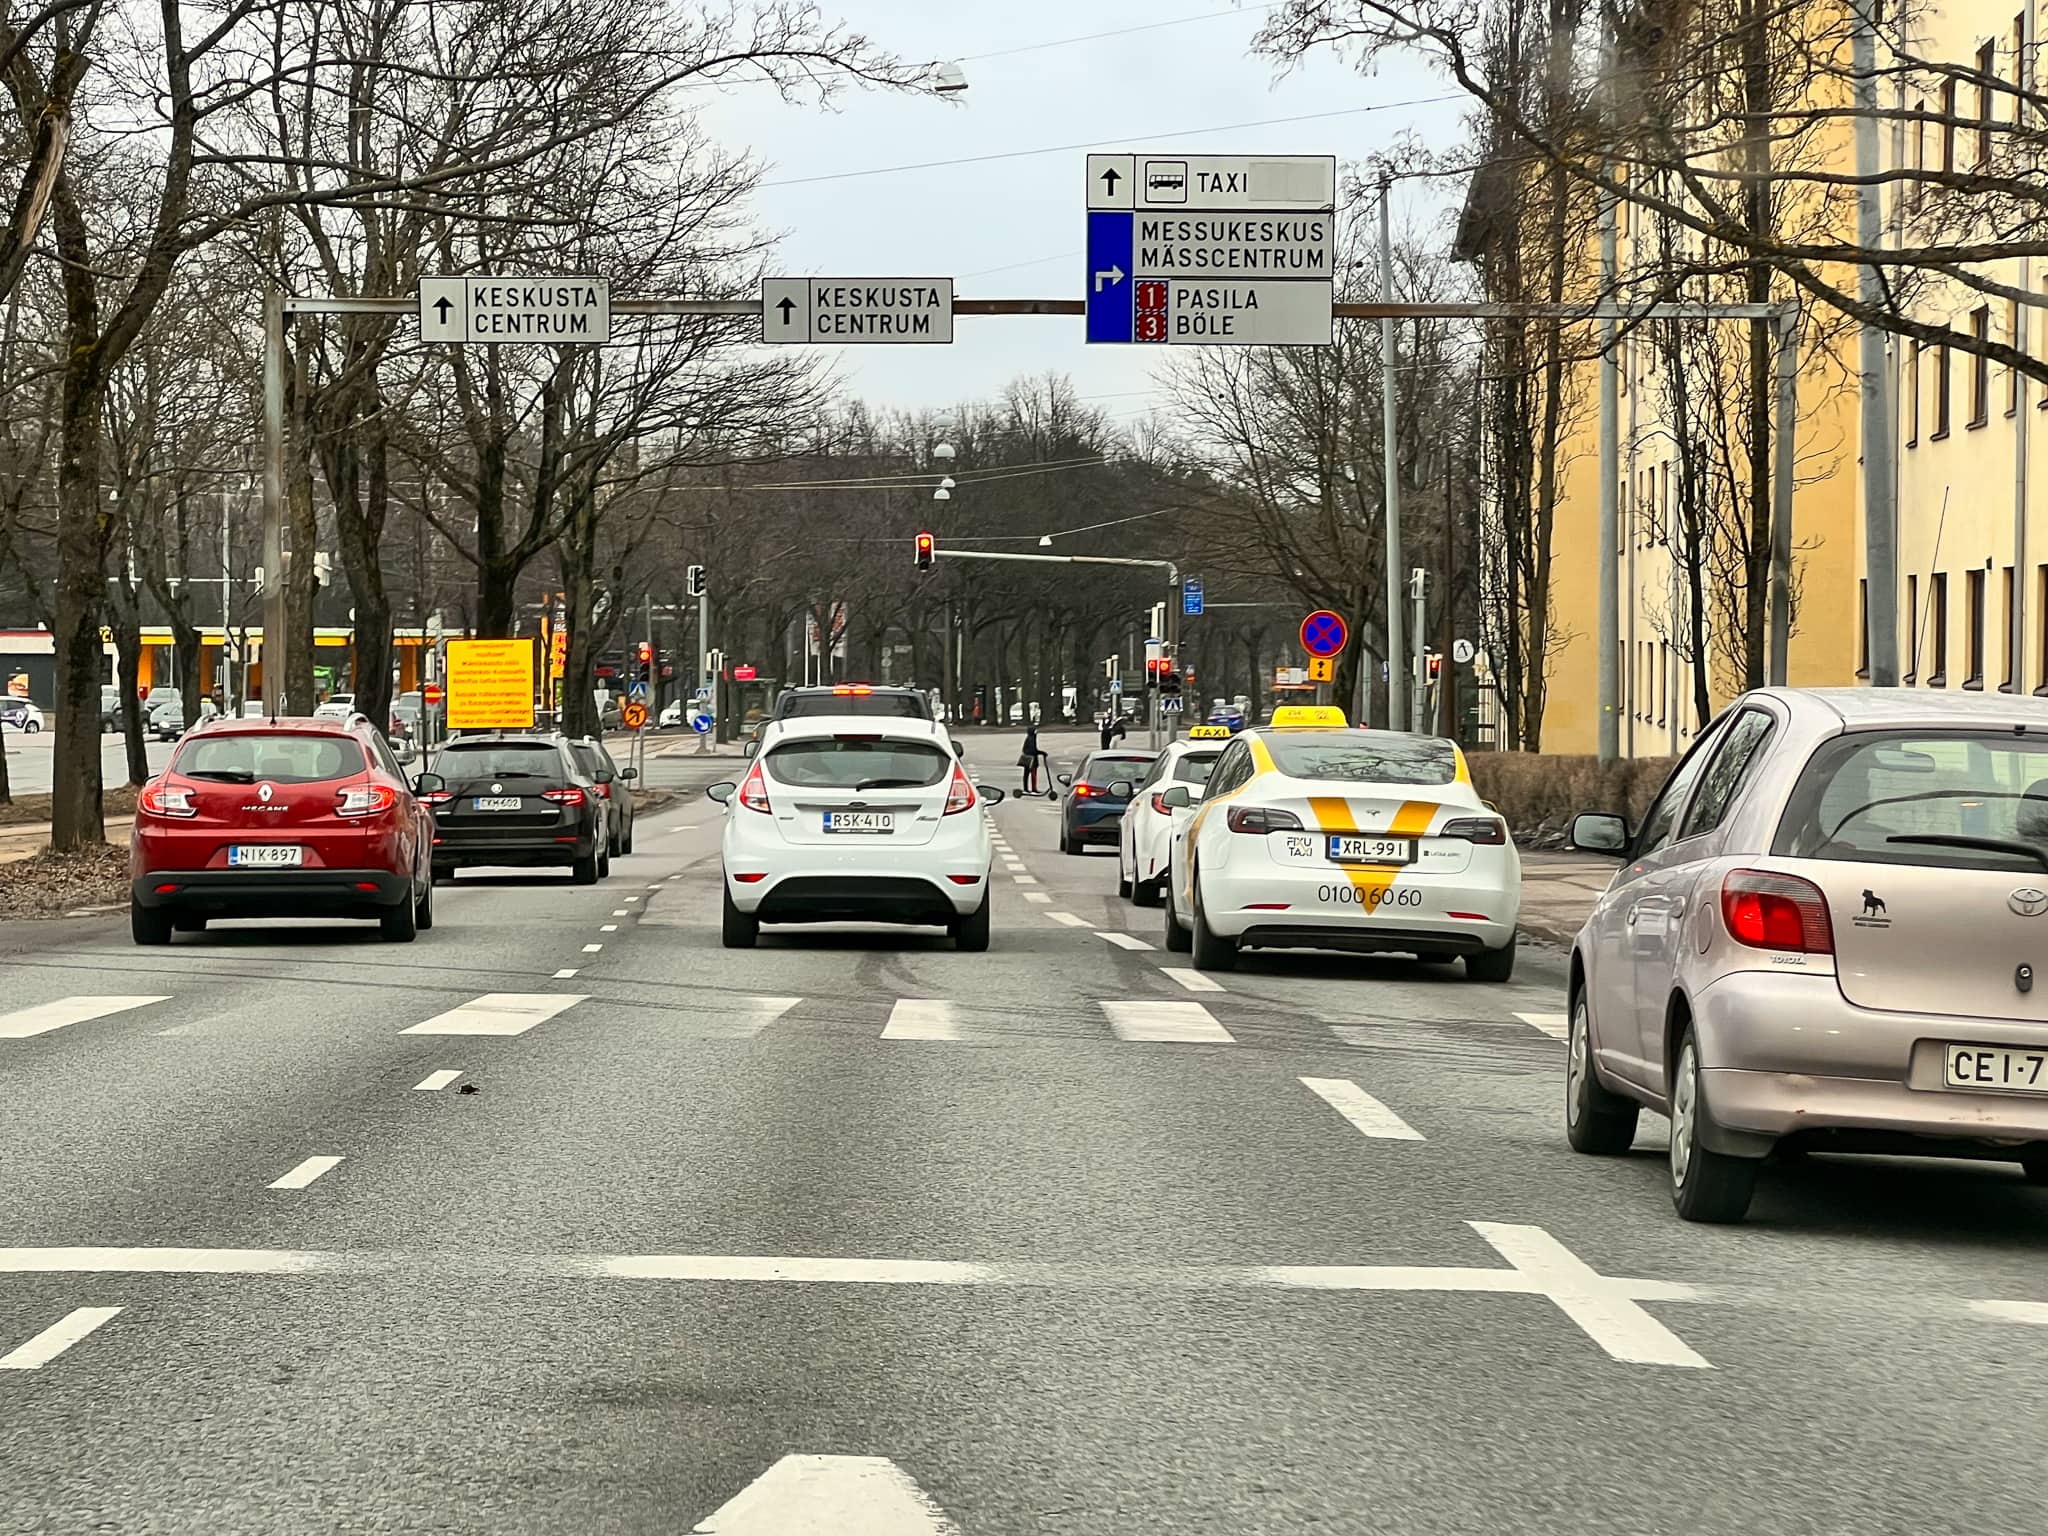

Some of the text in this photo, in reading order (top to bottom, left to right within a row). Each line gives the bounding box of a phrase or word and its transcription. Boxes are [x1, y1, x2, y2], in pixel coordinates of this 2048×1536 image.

[1197, 172, 1247, 193] TAXI
[1141, 221, 1324, 242] MESSUKESKUS
[1141, 244, 1324, 269] MÄSSCENTRUM
[474, 286, 598, 307] KESKUSTA
[817, 287, 940, 308] KESKUSTA
[1147, 287, 1154, 307] 1
[1176, 289, 1259, 310] PASILA
[475, 313, 588, 334] CENTRUM
[817, 313, 930, 334] CENTRUM
[1146, 317, 1157, 336] 3
[1176, 312, 1235, 335] BÖLE
[1196, 728, 1226, 737] TAXI
[833, 814, 891, 827] RSK-410
[1287, 836, 1312, 847] FIXU
[1288, 847, 1313, 857] TAXI
[1343, 839, 1403, 857] XRL-991
[240, 848, 297, 862] NIK-897
[1318, 885, 1422, 907] 0100 60 60
[1770, 954, 1807, 966] TOYOTA
